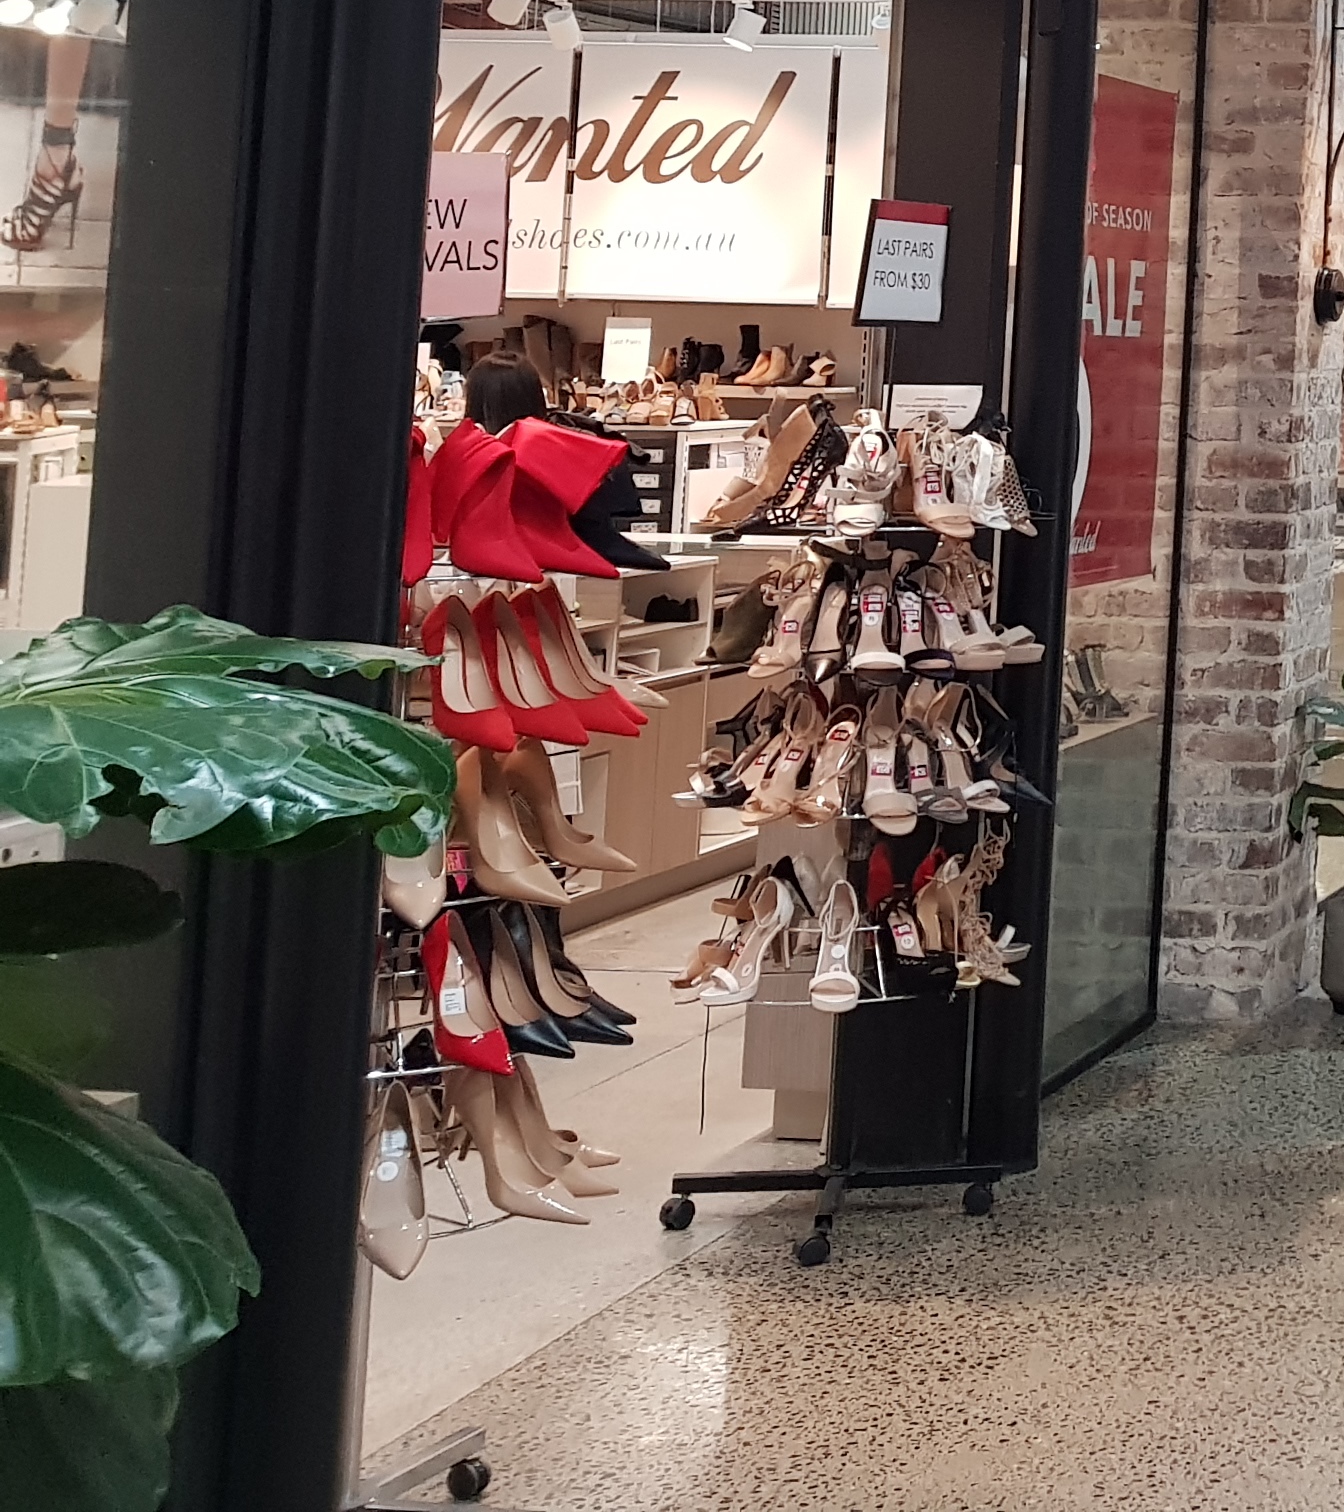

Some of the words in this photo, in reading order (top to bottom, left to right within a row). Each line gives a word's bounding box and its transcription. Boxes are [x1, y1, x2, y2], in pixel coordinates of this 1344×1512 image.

[1102, 203, 1153, 233] SEASON
[508, 219, 736, 252] shoes.com.au
[876, 239, 902, 256] LAST
[903, 240, 935, 259] PAIRS
[425, 239, 499, 272] VALS
[873, 270, 908, 288] FROM
[911, 272, 931, 291] $30
[1082, 254, 1146, 338] ALE
